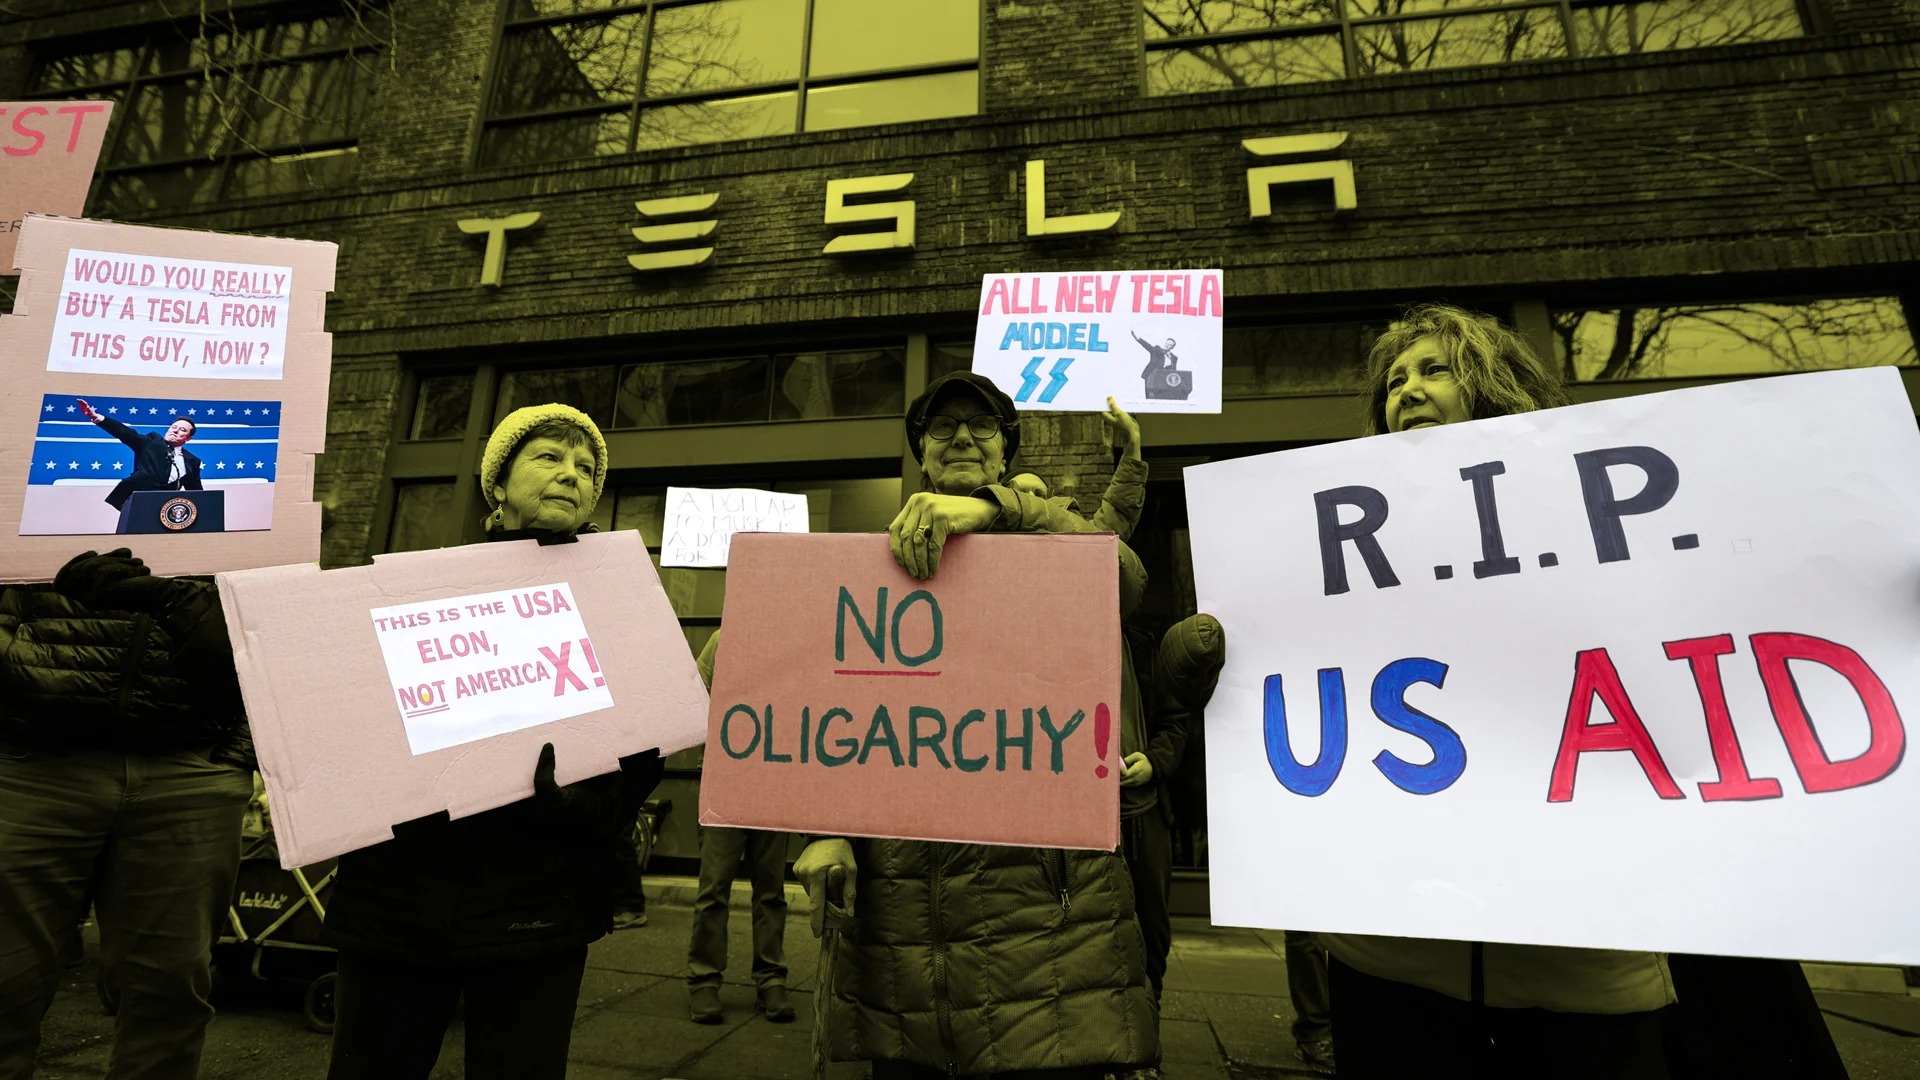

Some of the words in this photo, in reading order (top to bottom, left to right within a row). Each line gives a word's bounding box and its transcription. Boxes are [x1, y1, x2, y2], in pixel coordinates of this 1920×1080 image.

[0, 105, 104, 156] ST
[456, 131, 1357, 288] TESLA
[74, 258, 155, 287] WOULD
[164, 265, 205, 290] YOU
[211, 269, 286, 295] REALLY
[65, 291, 114, 318] BUY
[119, 296, 135, 320] A
[147, 298, 210, 325] TESLA
[220, 304, 276, 328] FROM
[982, 277, 1048, 315] ALL
[1054, 275, 1121, 313] NEW
[1130, 274, 1223, 317] TESLA
[70, 331, 126, 360] THIS
[139, 336, 189, 368] GUY,
[999, 322, 1109, 352] MODEL
[678, 491, 700, 513] A
[668, 530, 687, 547] A
[669, 513, 705, 530] TO
[713, 513, 766, 532] MUSK
[675, 547, 707, 563] FOR
[374, 612, 431, 632] THIS
[438, 607, 461, 623] IS
[464, 601, 506, 618] THE
[512, 588, 571, 619] USA
[835, 585, 943, 667] NO
[416, 630, 499, 664] ELON,
[398, 680, 448, 711] NOT
[1262, 657, 1467, 797] US
[1546, 631, 1906, 802] AID
[719, 702, 1111, 779] OLIGARCHY!
